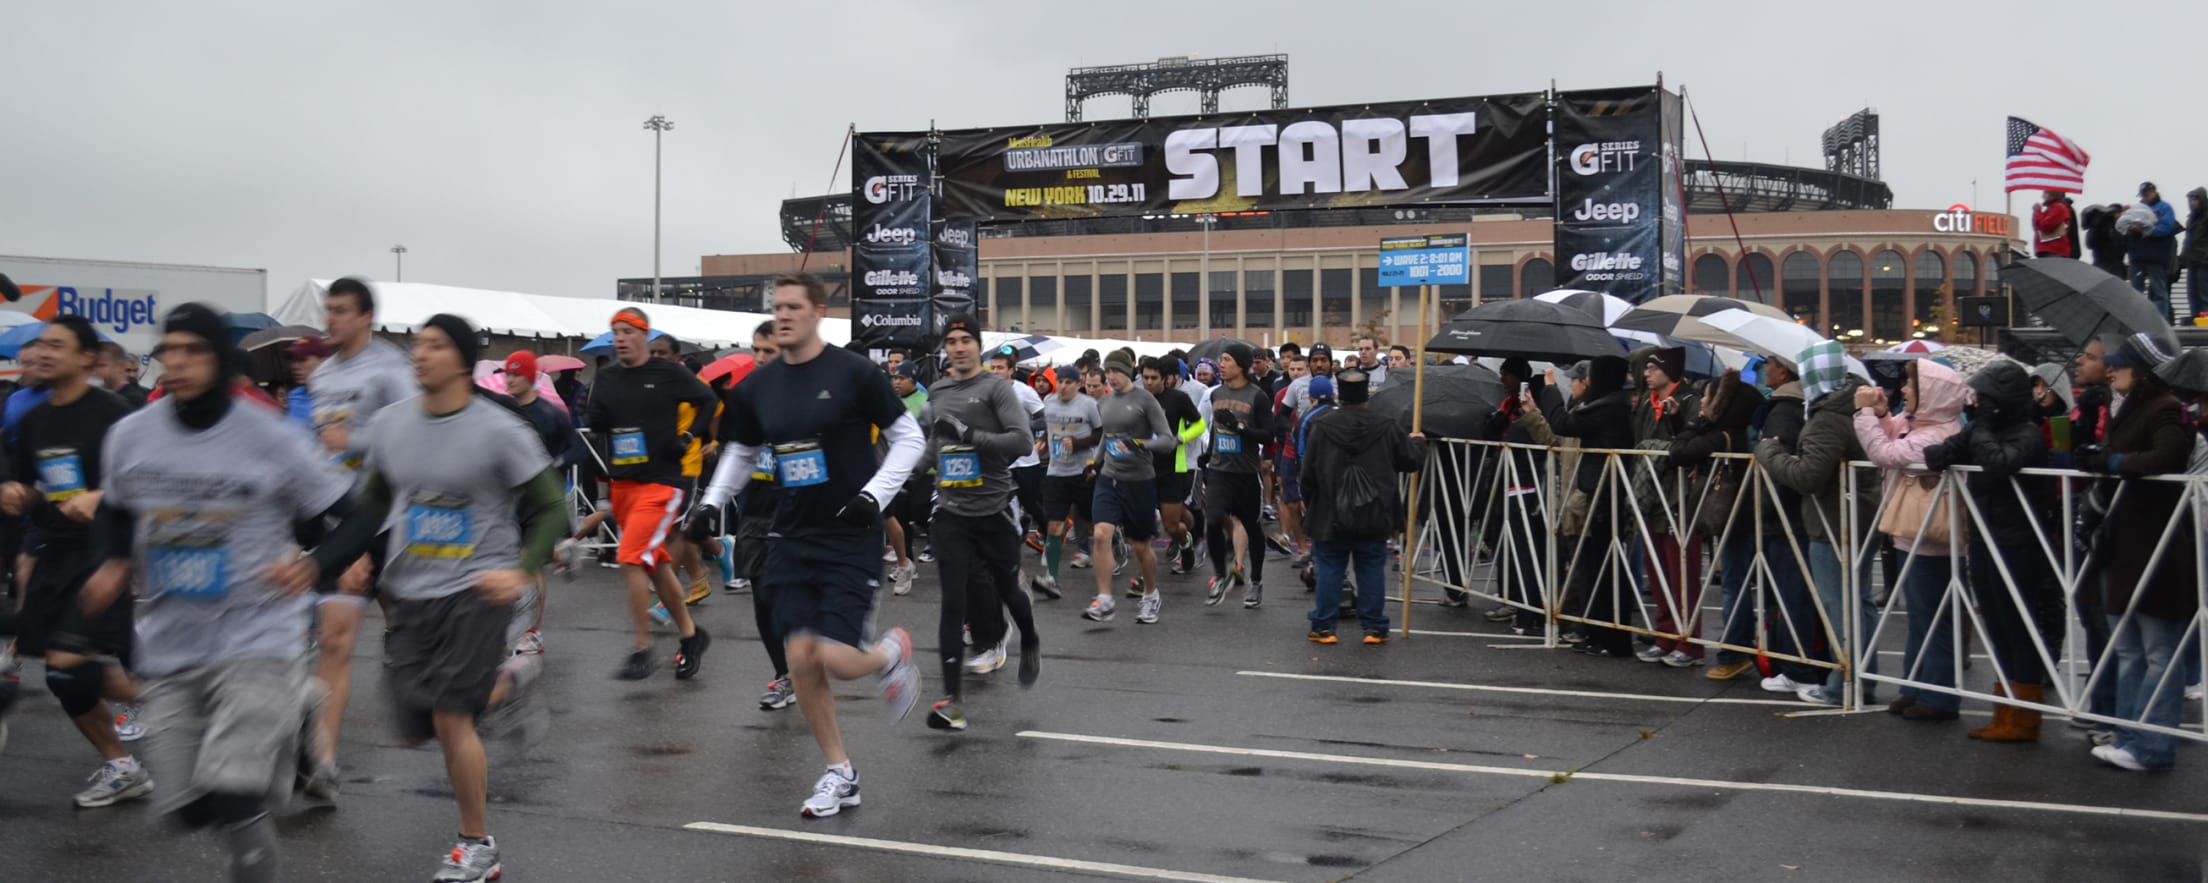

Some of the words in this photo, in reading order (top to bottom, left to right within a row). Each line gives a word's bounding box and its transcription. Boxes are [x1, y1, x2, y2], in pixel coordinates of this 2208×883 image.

[1117, 149, 1136, 161] FIT
[1601, 141, 1640, 151] SERIES
[1007, 147, 1099, 169] URBANATHLON
[1164, 112, 1476, 200] START
[1601, 150, 1639, 173] FIT
[888, 175, 918, 183] SERIES
[1072, 169, 1101, 179] FESTIVAL
[888, 183, 917, 202] FIT
[1004, 187, 1042, 207] NEW
[1043, 186, 1086, 206] YORK
[1087, 183, 1146, 204] 10.29.11
[1574, 198, 1640, 224] Jeep
[1933, 207, 1971, 232] citi
[866, 223, 916, 245] Jeep
[938, 223, 969, 248] Jeep
[1393, 254, 1419, 266] WAVE
[1419, 254, 1429, 265] 2:
[1429, 252, 1447, 264] 8:01
[1448, 251, 1462, 263] AM
[1571, 252, 1642, 271] Gillette
[864, 270, 919, 286] Gillette
[1409, 265, 1429, 278] 1001
[1437, 264, 1463, 277] 2000
[1585, 272, 1615, 281] ODOR
[1615, 272, 1644, 281] SHIELD
[875, 288, 899, 296] ODOR
[57, 286, 156, 334] Budget
[872, 314, 922, 327] Columbia
[1218, 437, 1236, 451] 1310
[781, 456, 820, 481] 1564
[945, 458, 974, 477] 1252
